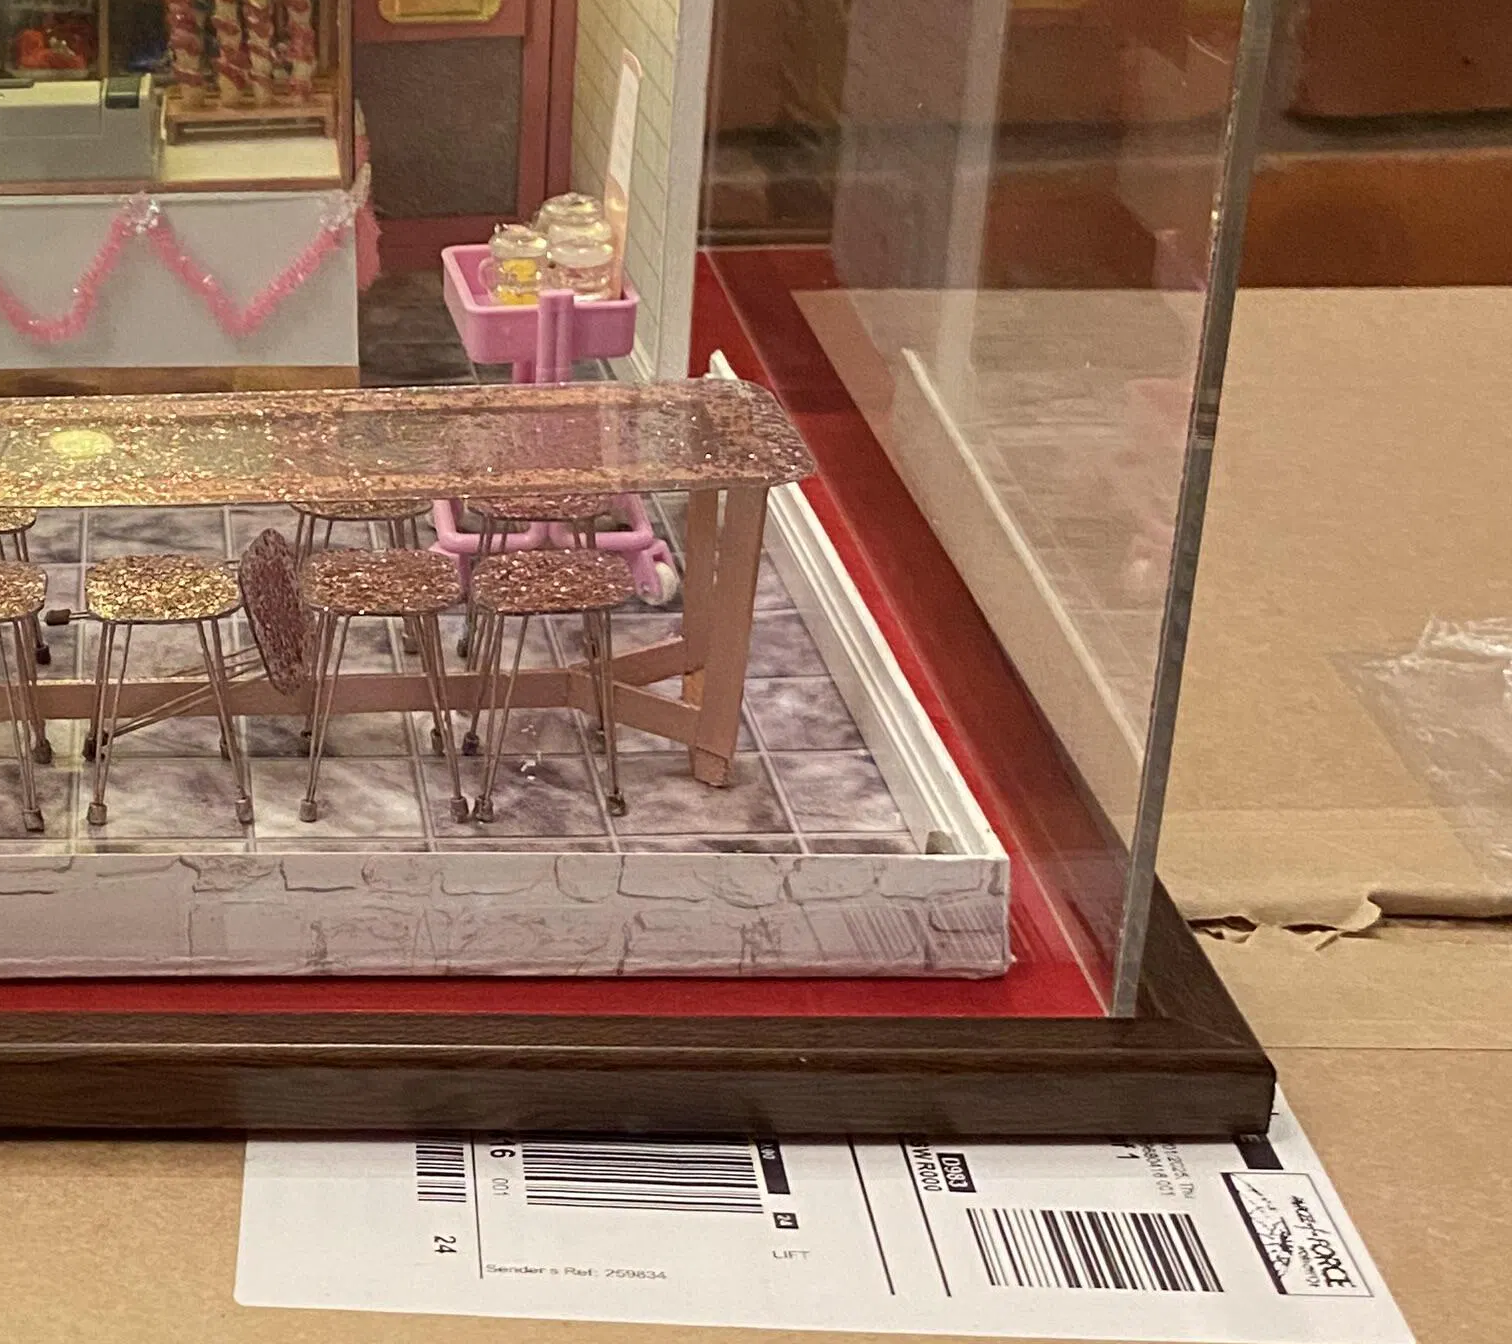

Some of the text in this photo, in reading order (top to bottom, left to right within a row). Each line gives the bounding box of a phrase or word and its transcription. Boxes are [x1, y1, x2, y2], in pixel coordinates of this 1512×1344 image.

[941, 1157, 968, 1187] D983
[492, 1177, 510, 1196] 001
[777, 1214, 793, 1226] 24
[434, 1235, 457, 1254] 24
[772, 1249, 810, 1259] LIFT
